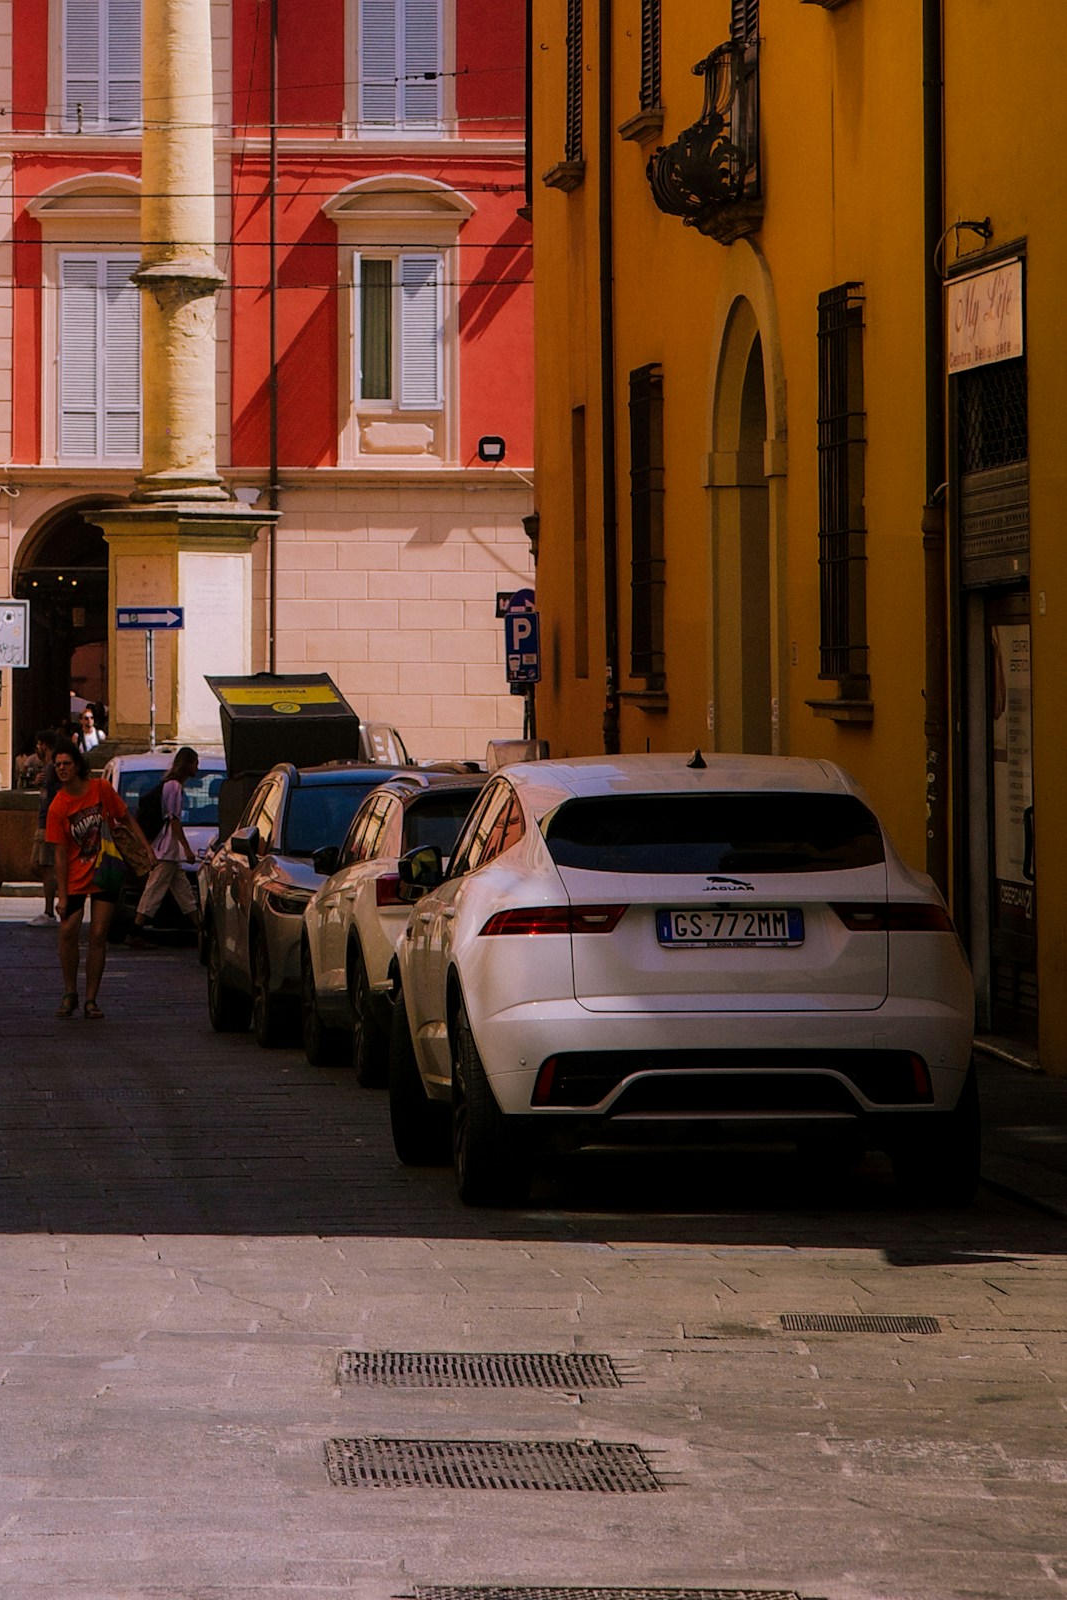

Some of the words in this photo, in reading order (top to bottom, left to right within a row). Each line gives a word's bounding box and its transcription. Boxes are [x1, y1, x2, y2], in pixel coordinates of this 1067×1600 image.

[954, 281, 980, 342] My
[982, 271, 1013, 336] Life
[950, 352, 971, 368] Centro
[513, 618, 531, 650] P
